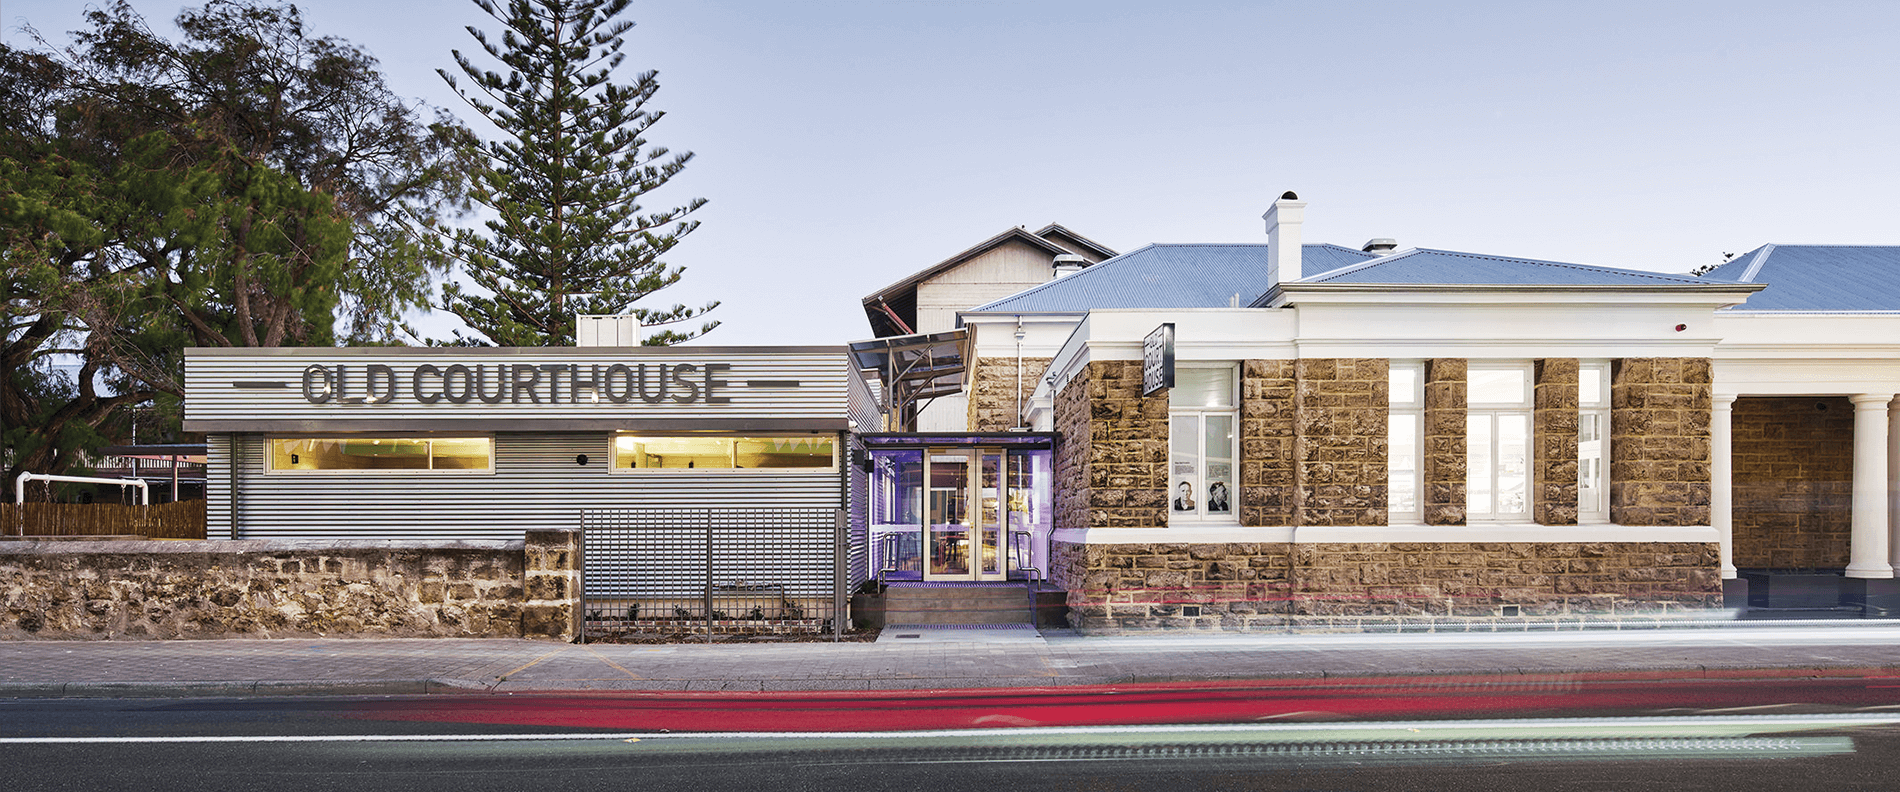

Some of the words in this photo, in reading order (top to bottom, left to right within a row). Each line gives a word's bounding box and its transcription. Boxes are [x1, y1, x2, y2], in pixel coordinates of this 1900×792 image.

[1144, 344, 1163, 371] COURT
[302, 363, 395, 404] OLD
[413, 363, 731, 404] COURTHOUSE
[1144, 366, 1163, 392] HOUSE
